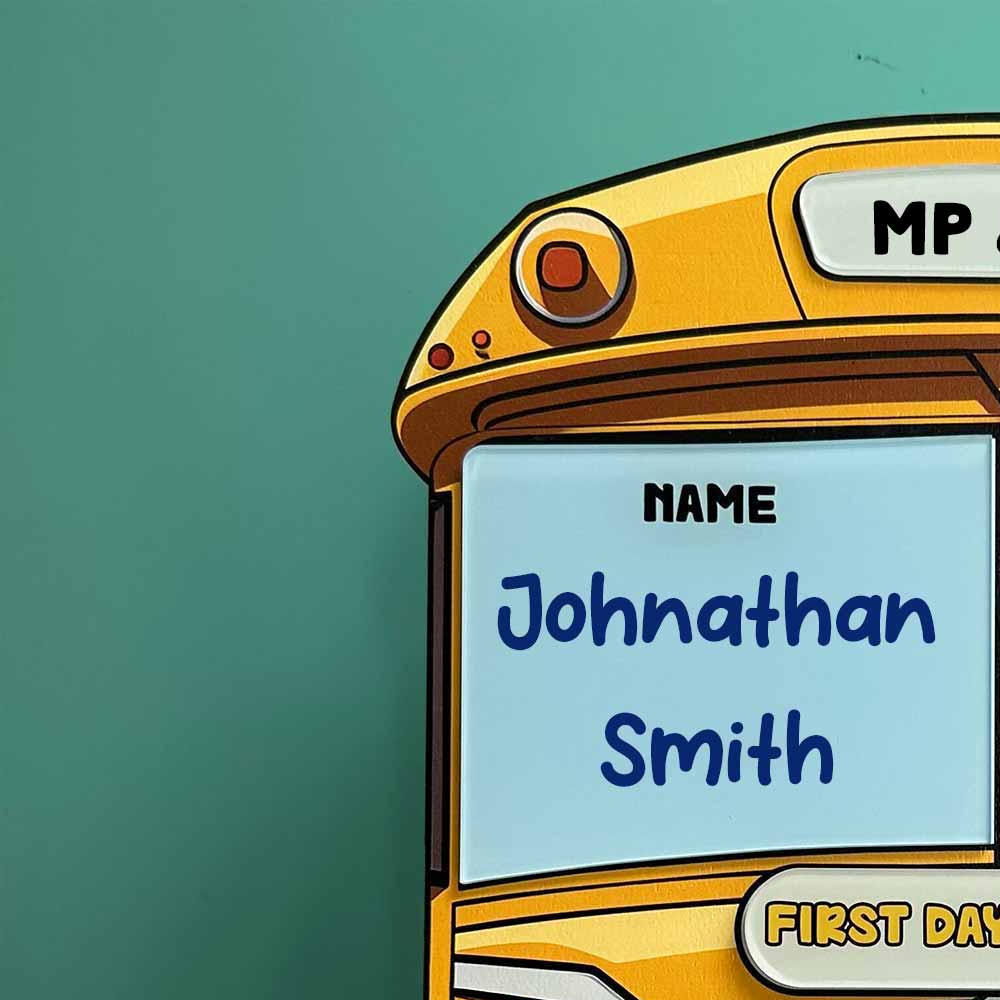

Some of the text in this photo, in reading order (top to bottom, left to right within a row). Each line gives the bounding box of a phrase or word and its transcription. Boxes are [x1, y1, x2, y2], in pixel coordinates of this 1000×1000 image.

[874, 200, 971, 255] MP
[643, 482, 778, 524] NAME
[497, 571, 936, 651] Johnathan
[600, 709, 834, 788] Smith
[764, 900, 913, 948] FIRST
